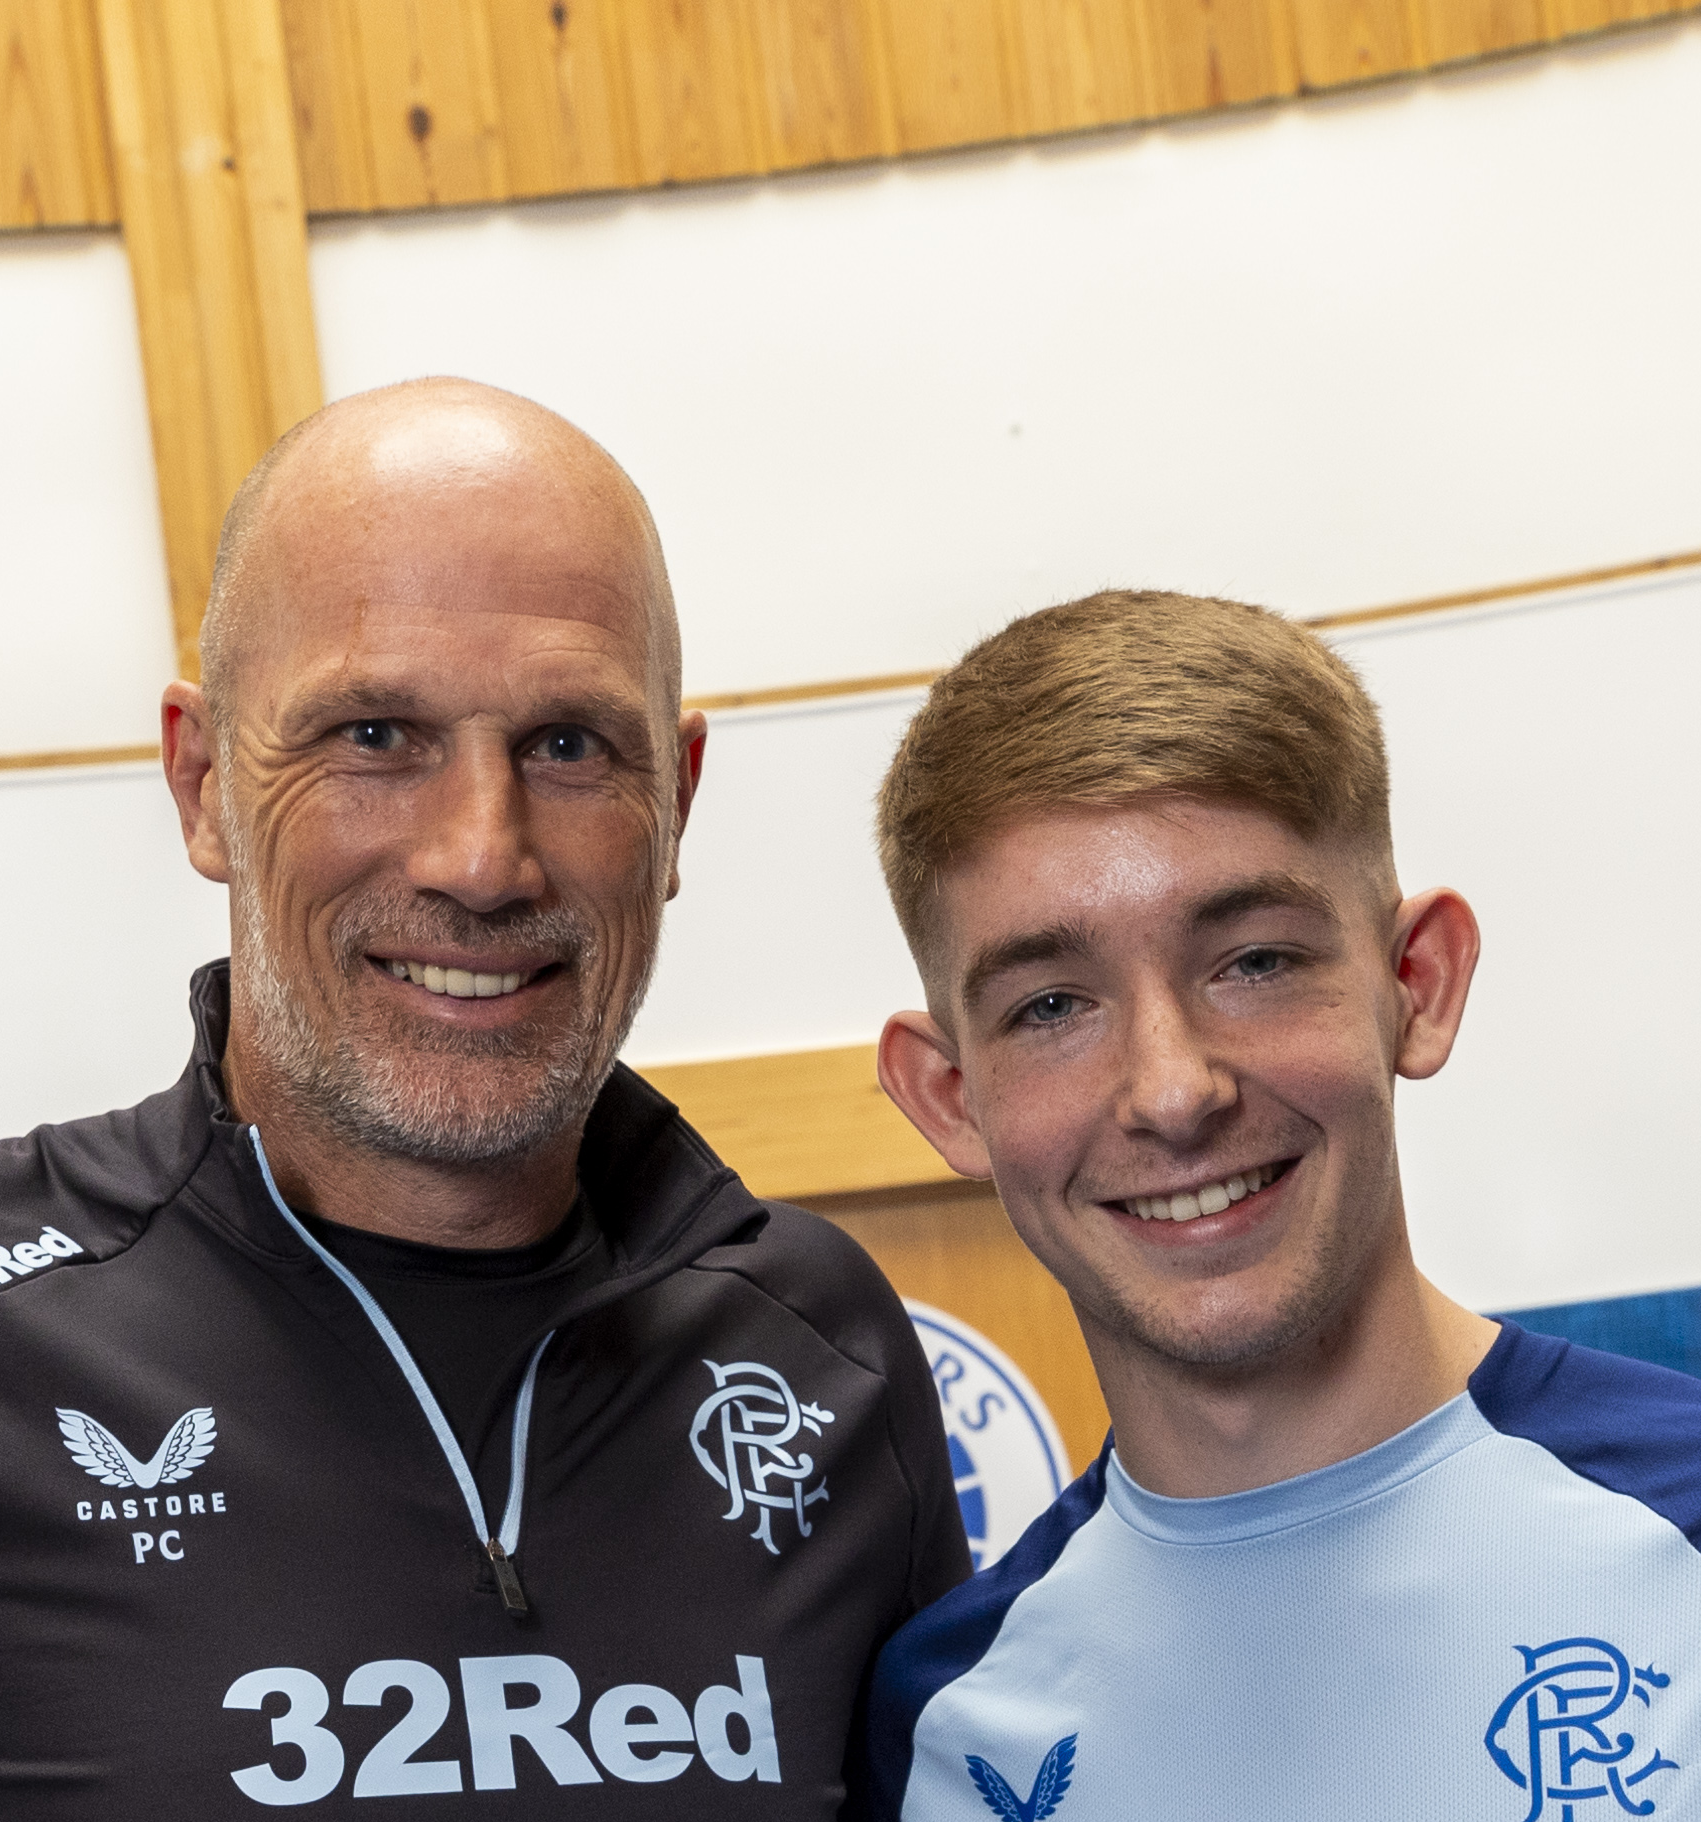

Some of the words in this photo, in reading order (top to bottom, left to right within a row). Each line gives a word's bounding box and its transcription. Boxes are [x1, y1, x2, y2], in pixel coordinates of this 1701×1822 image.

[76, 1491, 227, 1521] CASTORE
[132, 1530, 185, 1564] PC
[222, 1655, 781, 1806] 32Red
